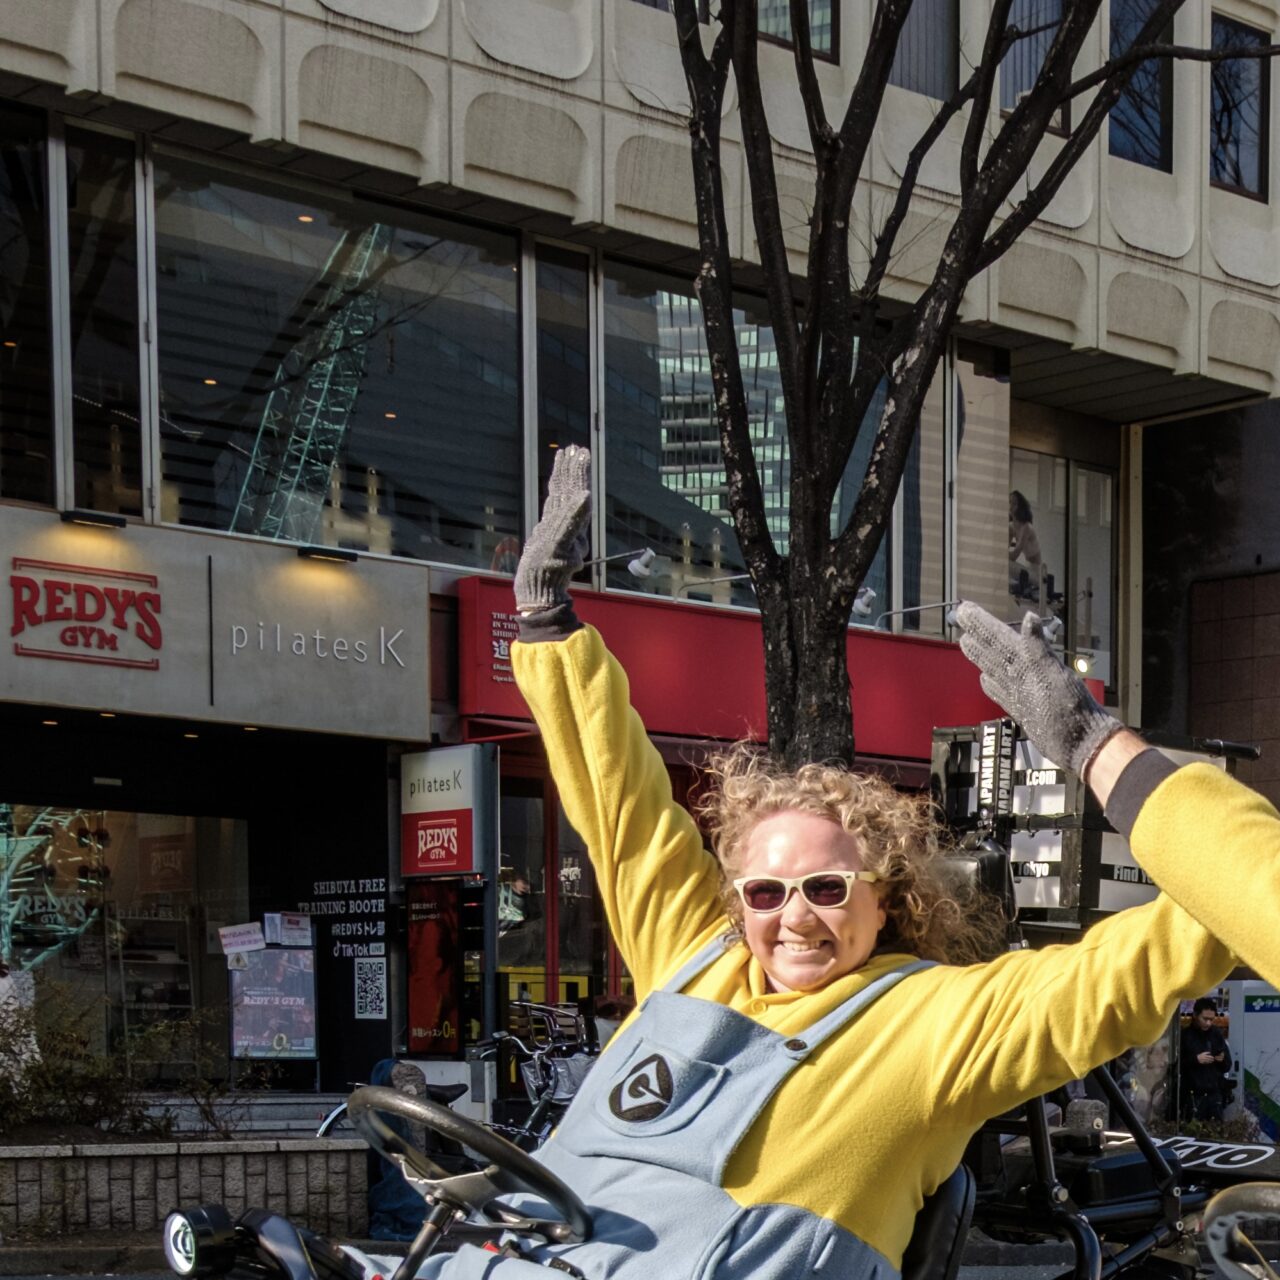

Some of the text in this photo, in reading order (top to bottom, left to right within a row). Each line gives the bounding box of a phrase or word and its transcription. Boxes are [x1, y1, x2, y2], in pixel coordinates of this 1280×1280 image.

[60, 626, 119, 651] GYM
[231, 621, 368, 663] pilates
[410, 777, 451, 799] pilates
[430, 847, 446, 859] GYM
[1113, 864, 1140, 883] Find
[313, 878, 386, 895] SHIBUYA FREE
[297, 899, 385, 915] TRAINING BOOTH
[341, 943, 369, 957] TikTok
